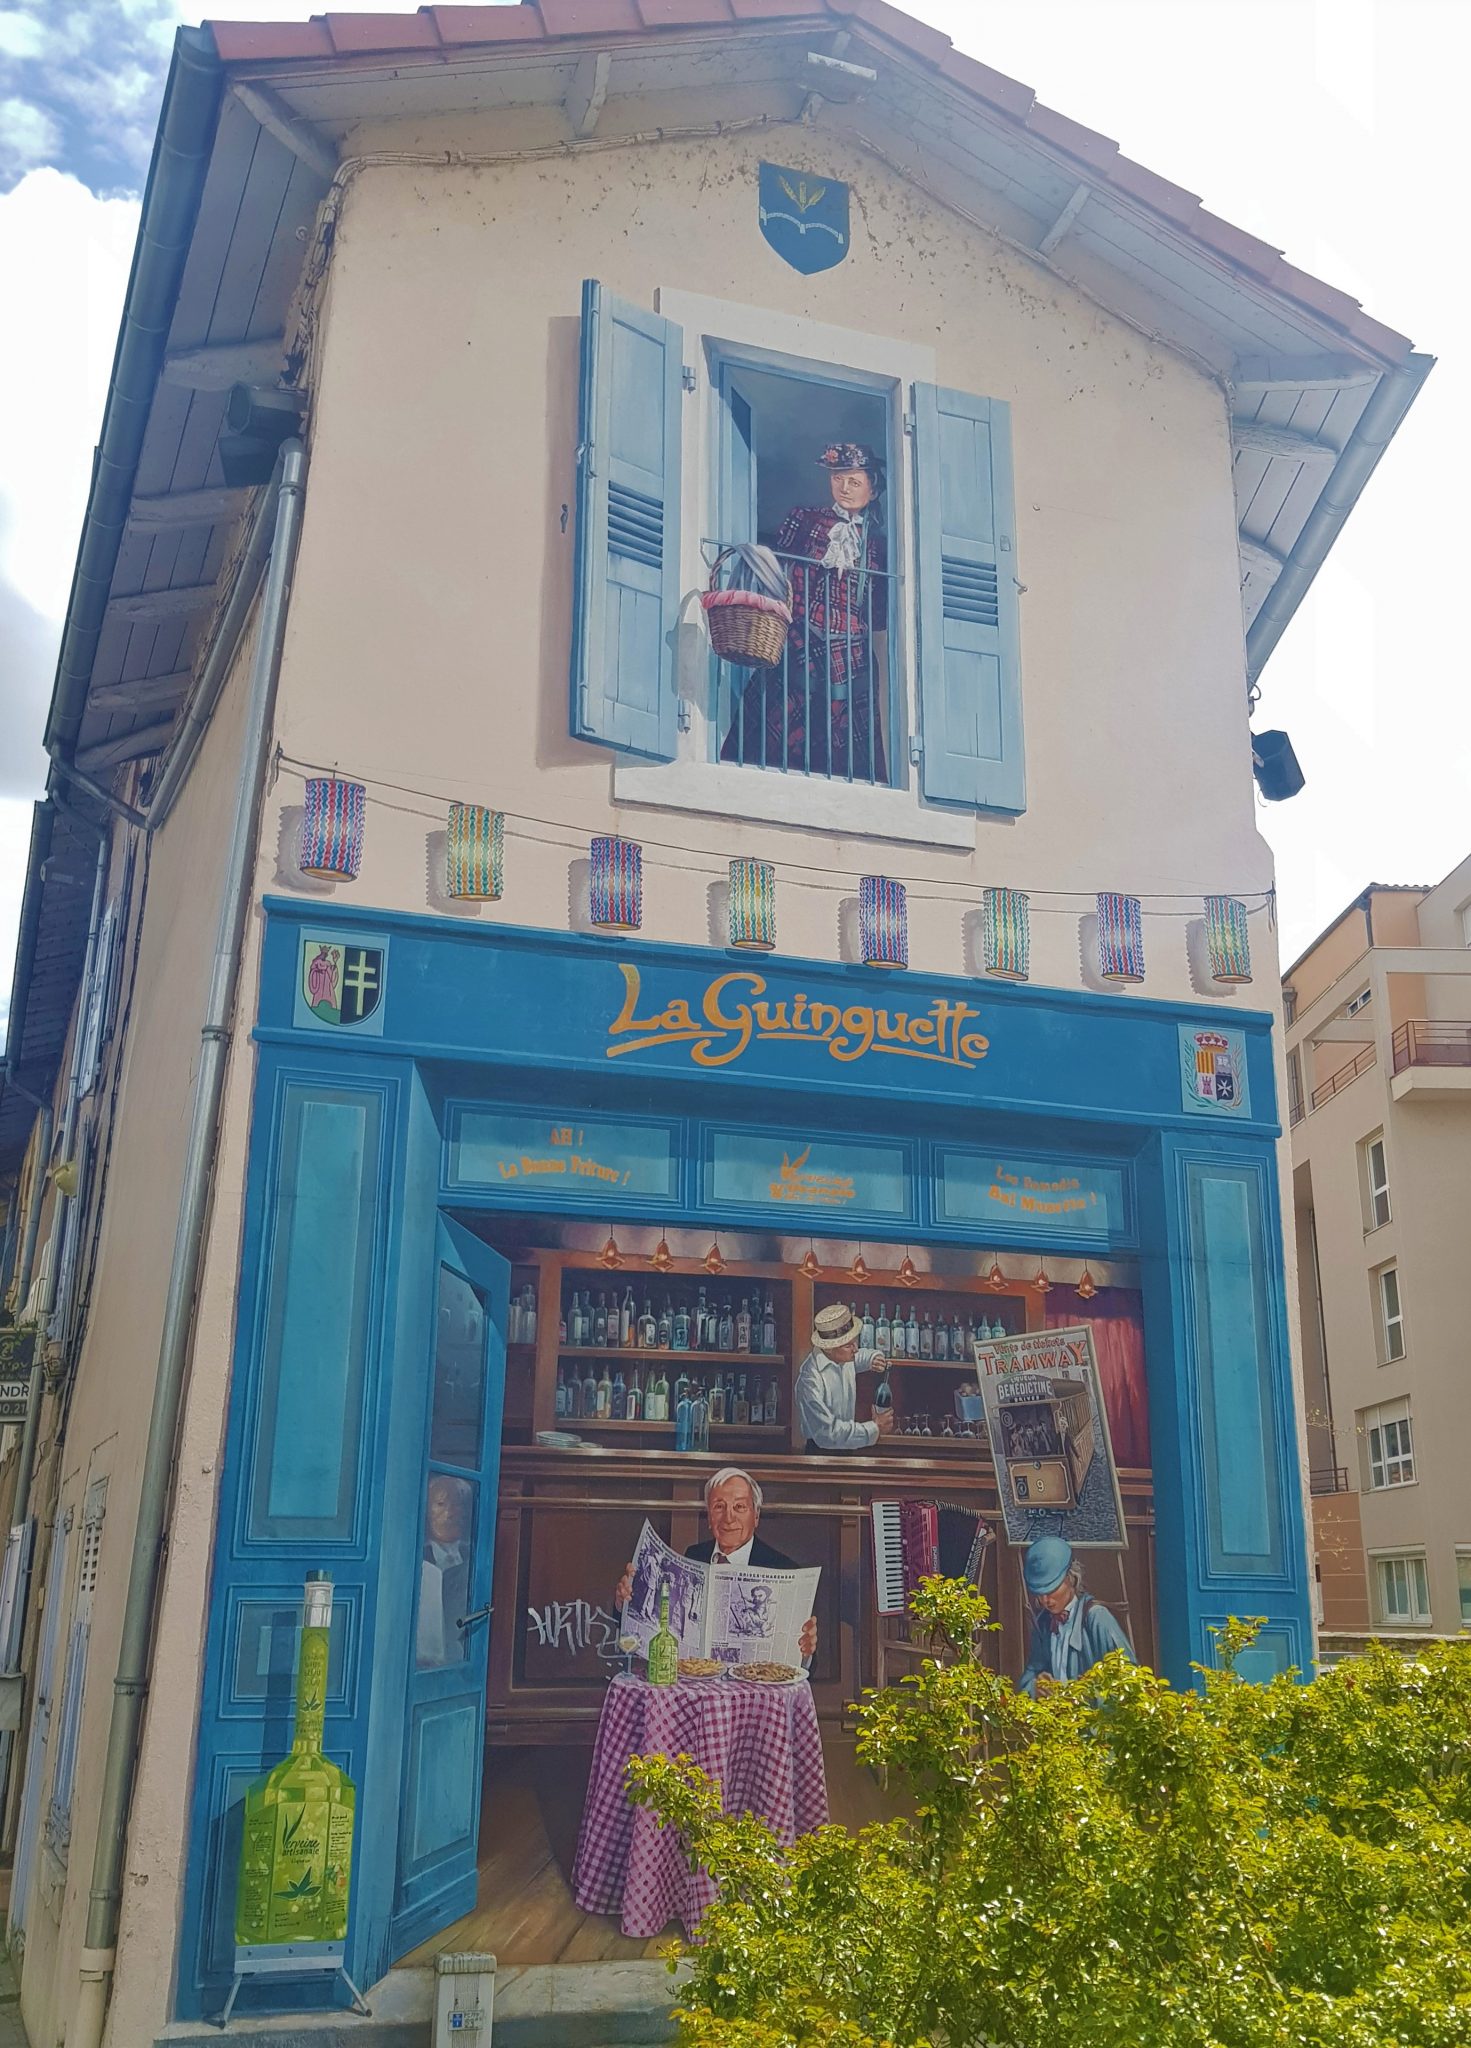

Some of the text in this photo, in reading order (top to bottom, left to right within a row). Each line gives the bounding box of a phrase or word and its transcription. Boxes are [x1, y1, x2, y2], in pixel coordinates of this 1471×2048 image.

[607, 963, 990, 1067] La Guinguette
[551, 1127, 573, 1146] AH
[978, 1341, 1088, 1376] TRAMWAY
[1036, 1479, 1044, 1492] 9
